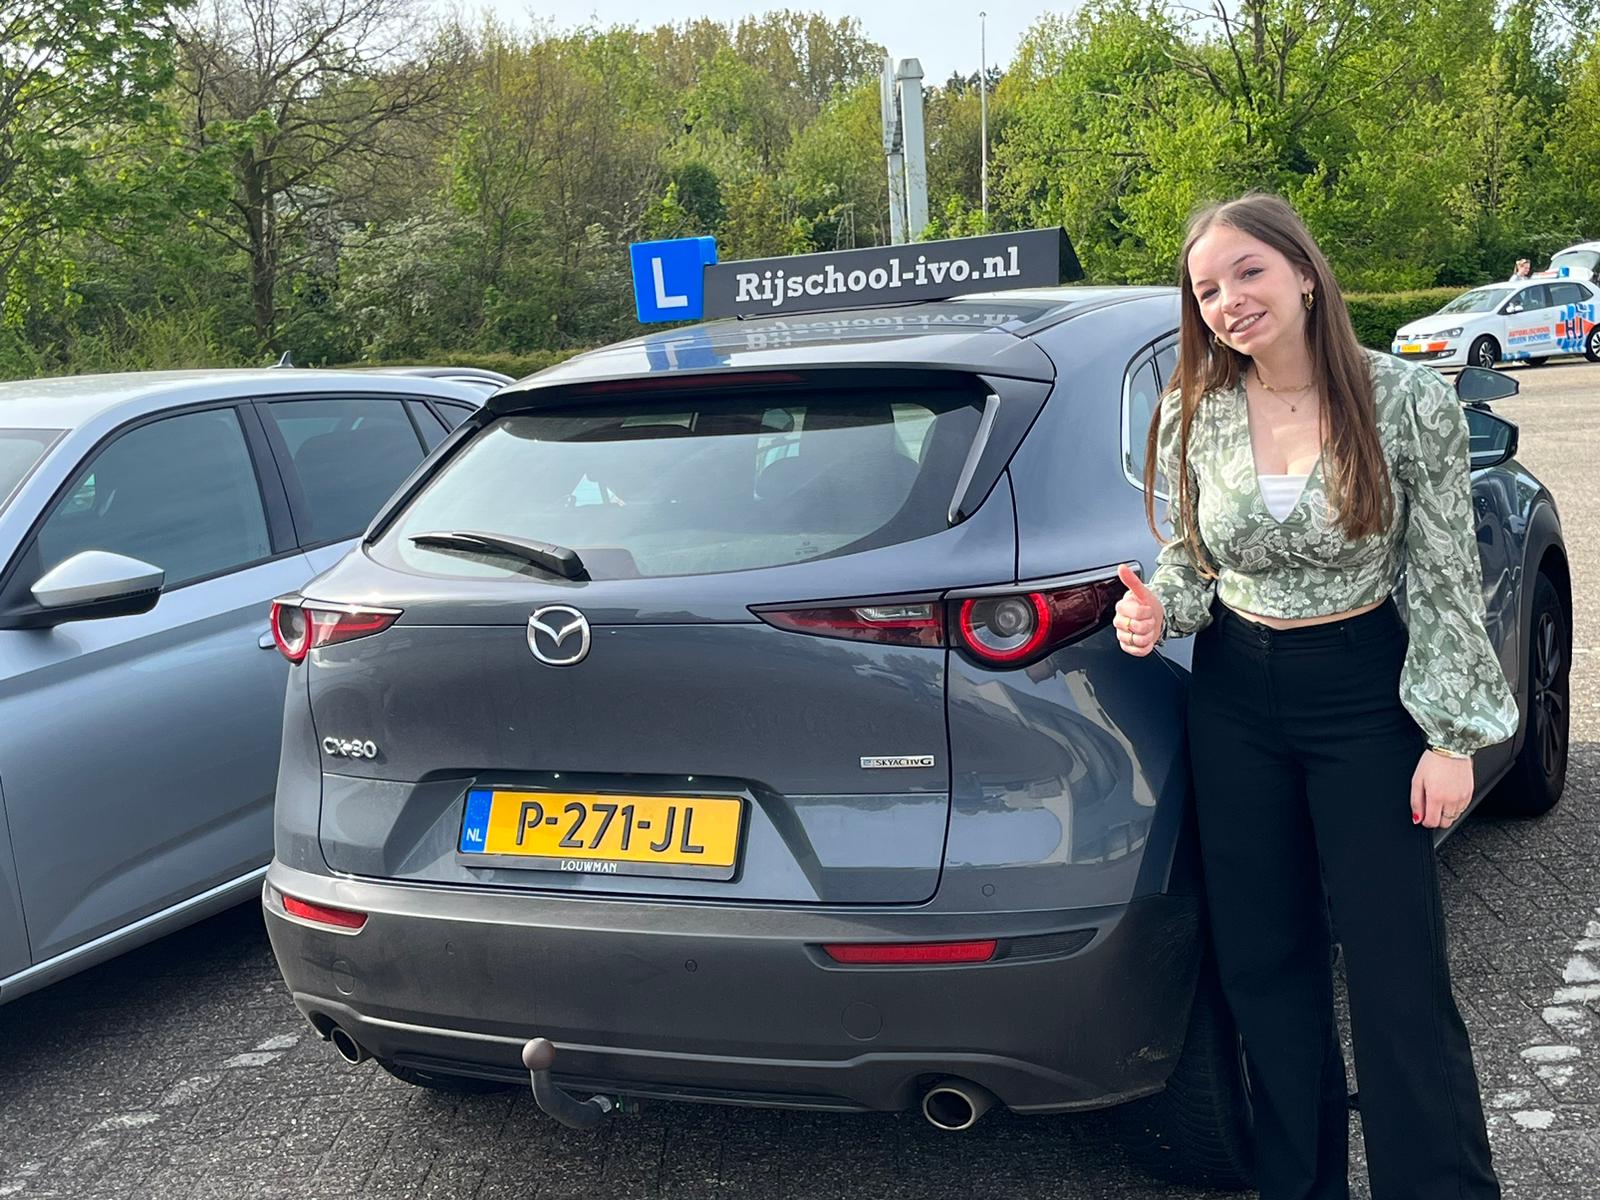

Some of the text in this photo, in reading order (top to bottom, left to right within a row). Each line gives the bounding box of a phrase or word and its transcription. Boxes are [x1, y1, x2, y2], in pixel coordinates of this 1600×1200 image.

[651, 257, 689, 309] L
[736, 246, 1020, 306] Rijschool-ivo.nl
[323, 737, 377, 758] CX-30
[466, 827, 483, 843] NL
[516, 801, 704, 853] P-271-JL
[560, 860, 618, 873] LOUWMAN
